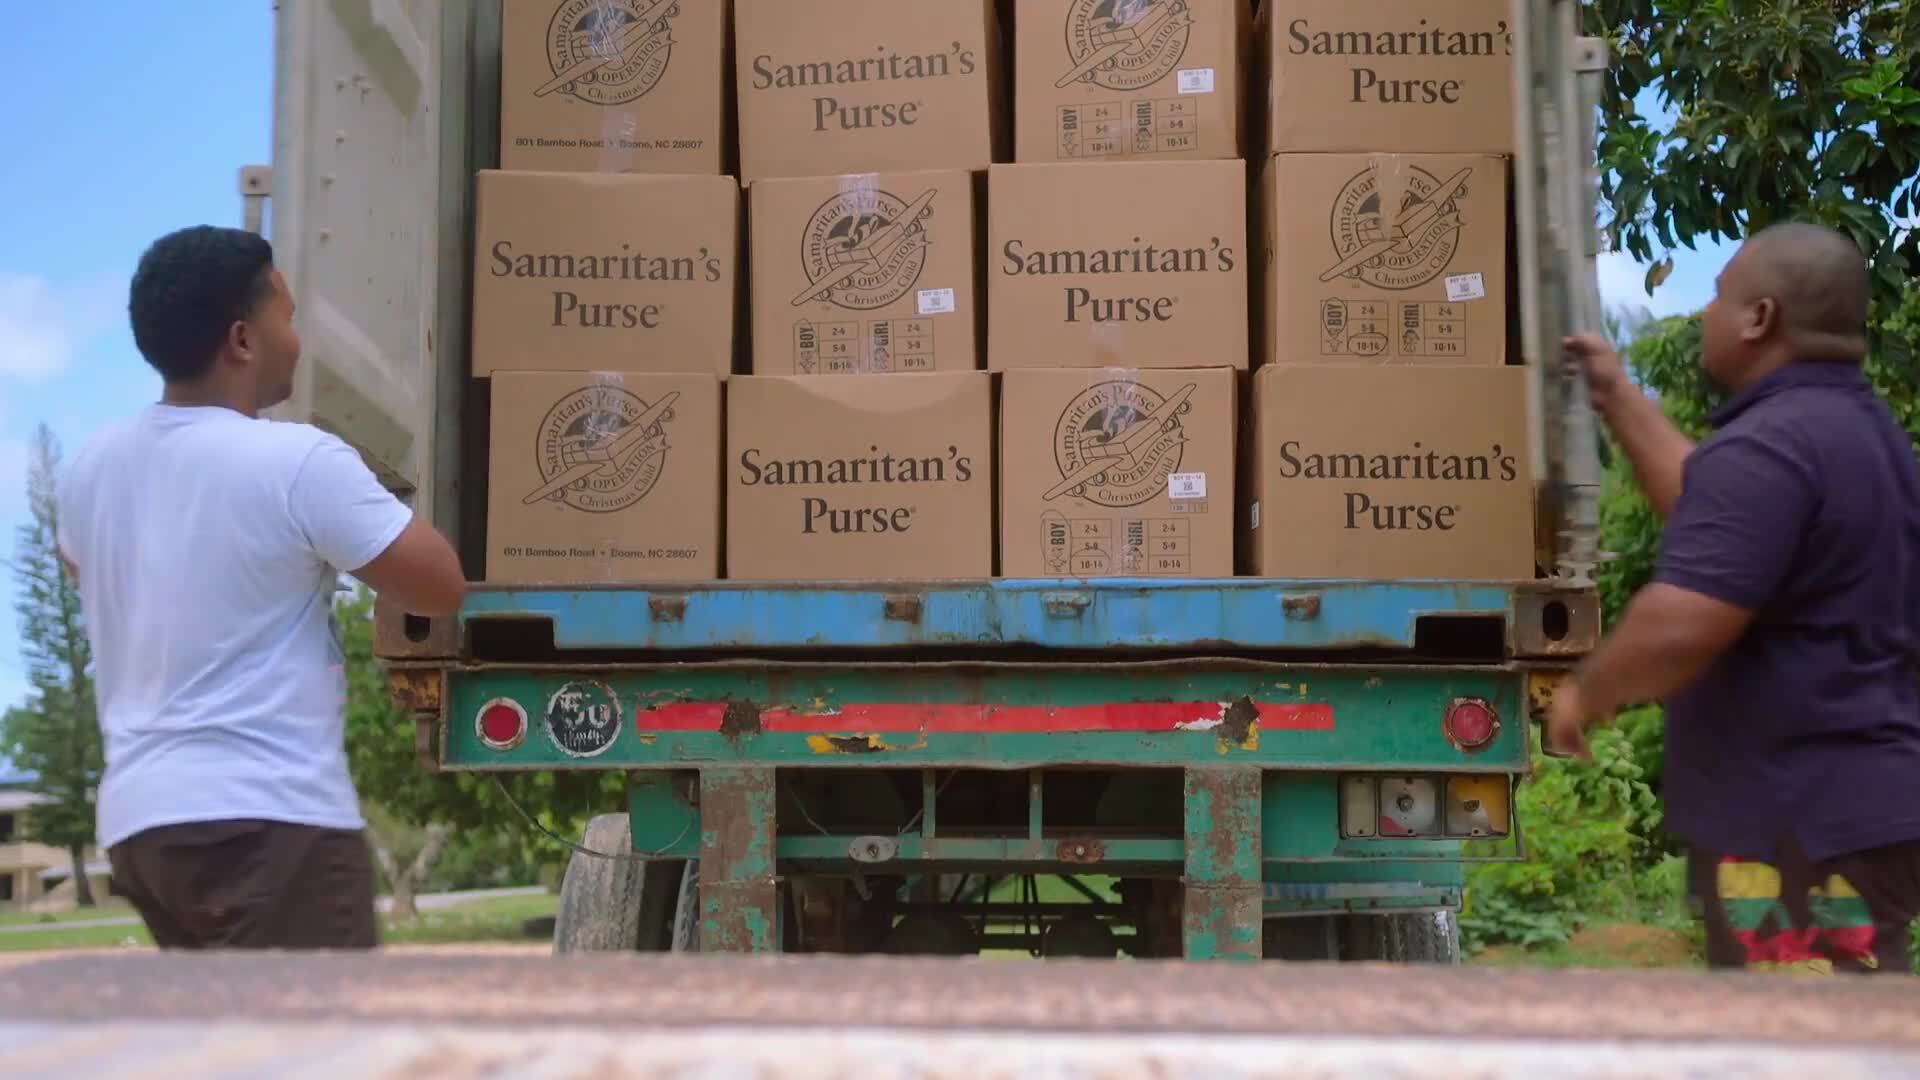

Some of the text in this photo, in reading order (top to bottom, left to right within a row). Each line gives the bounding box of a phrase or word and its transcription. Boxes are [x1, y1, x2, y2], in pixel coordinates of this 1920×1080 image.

[601, 38, 662, 82] OPERATION
[1121, 18, 1181, 68] OPERATION
[1160, 39, 1181, 68] Child
[640, 57, 662, 86] Child
[753, 40, 976, 90] Samaritan's
[1350, 67, 1461, 104] Purse
[812, 97, 918, 132] Purse
[1063, 108, 1078, 130] BOY
[1136, 101, 1152, 127] GIRL
[536, 137, 577, 148] Bamboo
[655, 140, 671, 149] NC
[490, 240, 721, 282] Samaritan's
[1002, 236, 1234, 276] Samaritan's
[1388, 219, 1450, 267] OPERATION
[858, 240, 917, 287] OPERATION
[1375, 240, 1451, 285] Christmas Child
[844, 259, 918, 305] Christmas Child
[552, 291, 660, 329] Purse
[1063, 287, 1174, 323] Purse
[1327, 303, 1343, 326] BOY
[1404, 303, 1420, 328] GIRL
[799, 326, 815, 349] BOY
[593, 441, 657, 490] OPERATION
[740, 445, 972, 486] Samaritan's
[1112, 435, 1174, 484] OPERATION
[1280, 440, 1517, 482] Samaritan's
[578, 463, 657, 509] Christmas Child
[1098, 456, 1175, 503] Christmas Child
[801, 497, 911, 534] Purse
[1343, 492, 1456, 531] Purse
[525, 547, 567, 557] Bamboo
[648, 549, 667, 558] NC
[1050, 522, 1066, 545] BOY
[1158, 559, 1181, 569] 10-14
